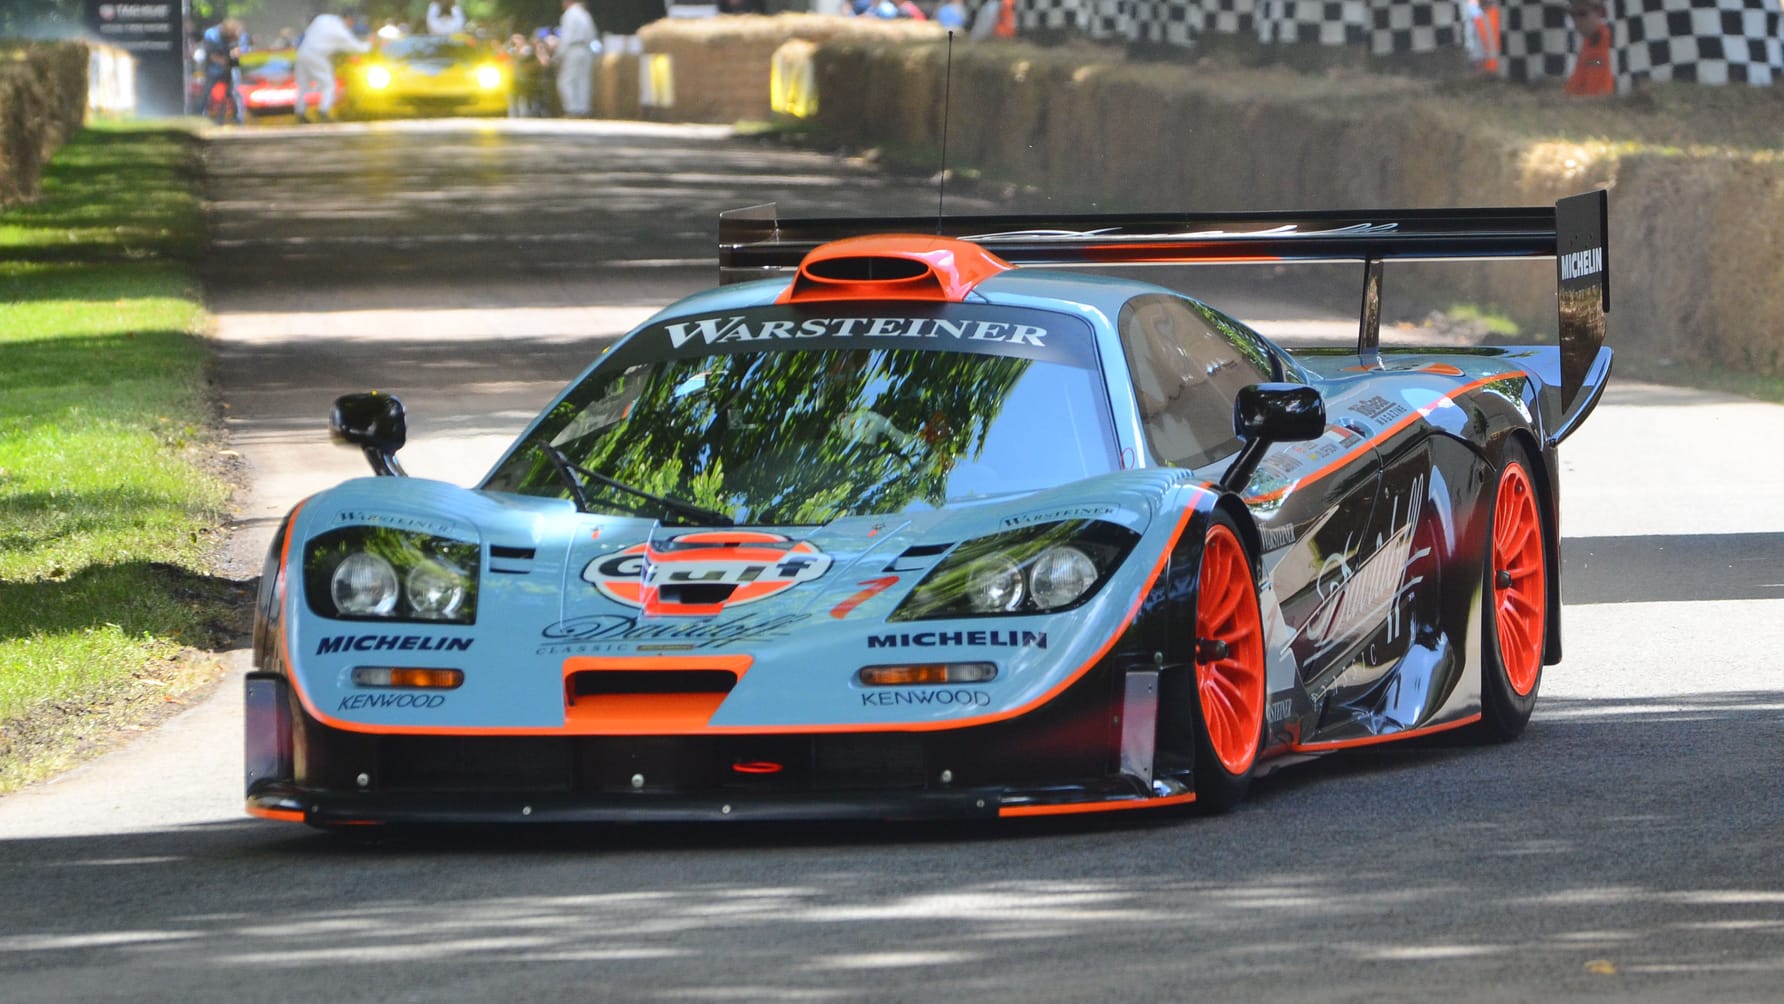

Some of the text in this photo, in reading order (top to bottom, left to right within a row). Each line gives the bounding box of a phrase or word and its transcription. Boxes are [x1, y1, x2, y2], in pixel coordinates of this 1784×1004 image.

[1561, 247, 1603, 280] MICHELIN
[664, 315, 1050, 349] WARSTEINER
[1376, 404, 1408, 425] MAGAZINE
[598, 553, 813, 582] Gulf
[315, 635, 475, 657] MICHELIN
[536, 644, 629, 656] CLASSIC
[867, 630, 1048, 650] MICHELIN
[337, 694, 446, 713] KENWOOD
[860, 689, 991, 707] KENWOOD
